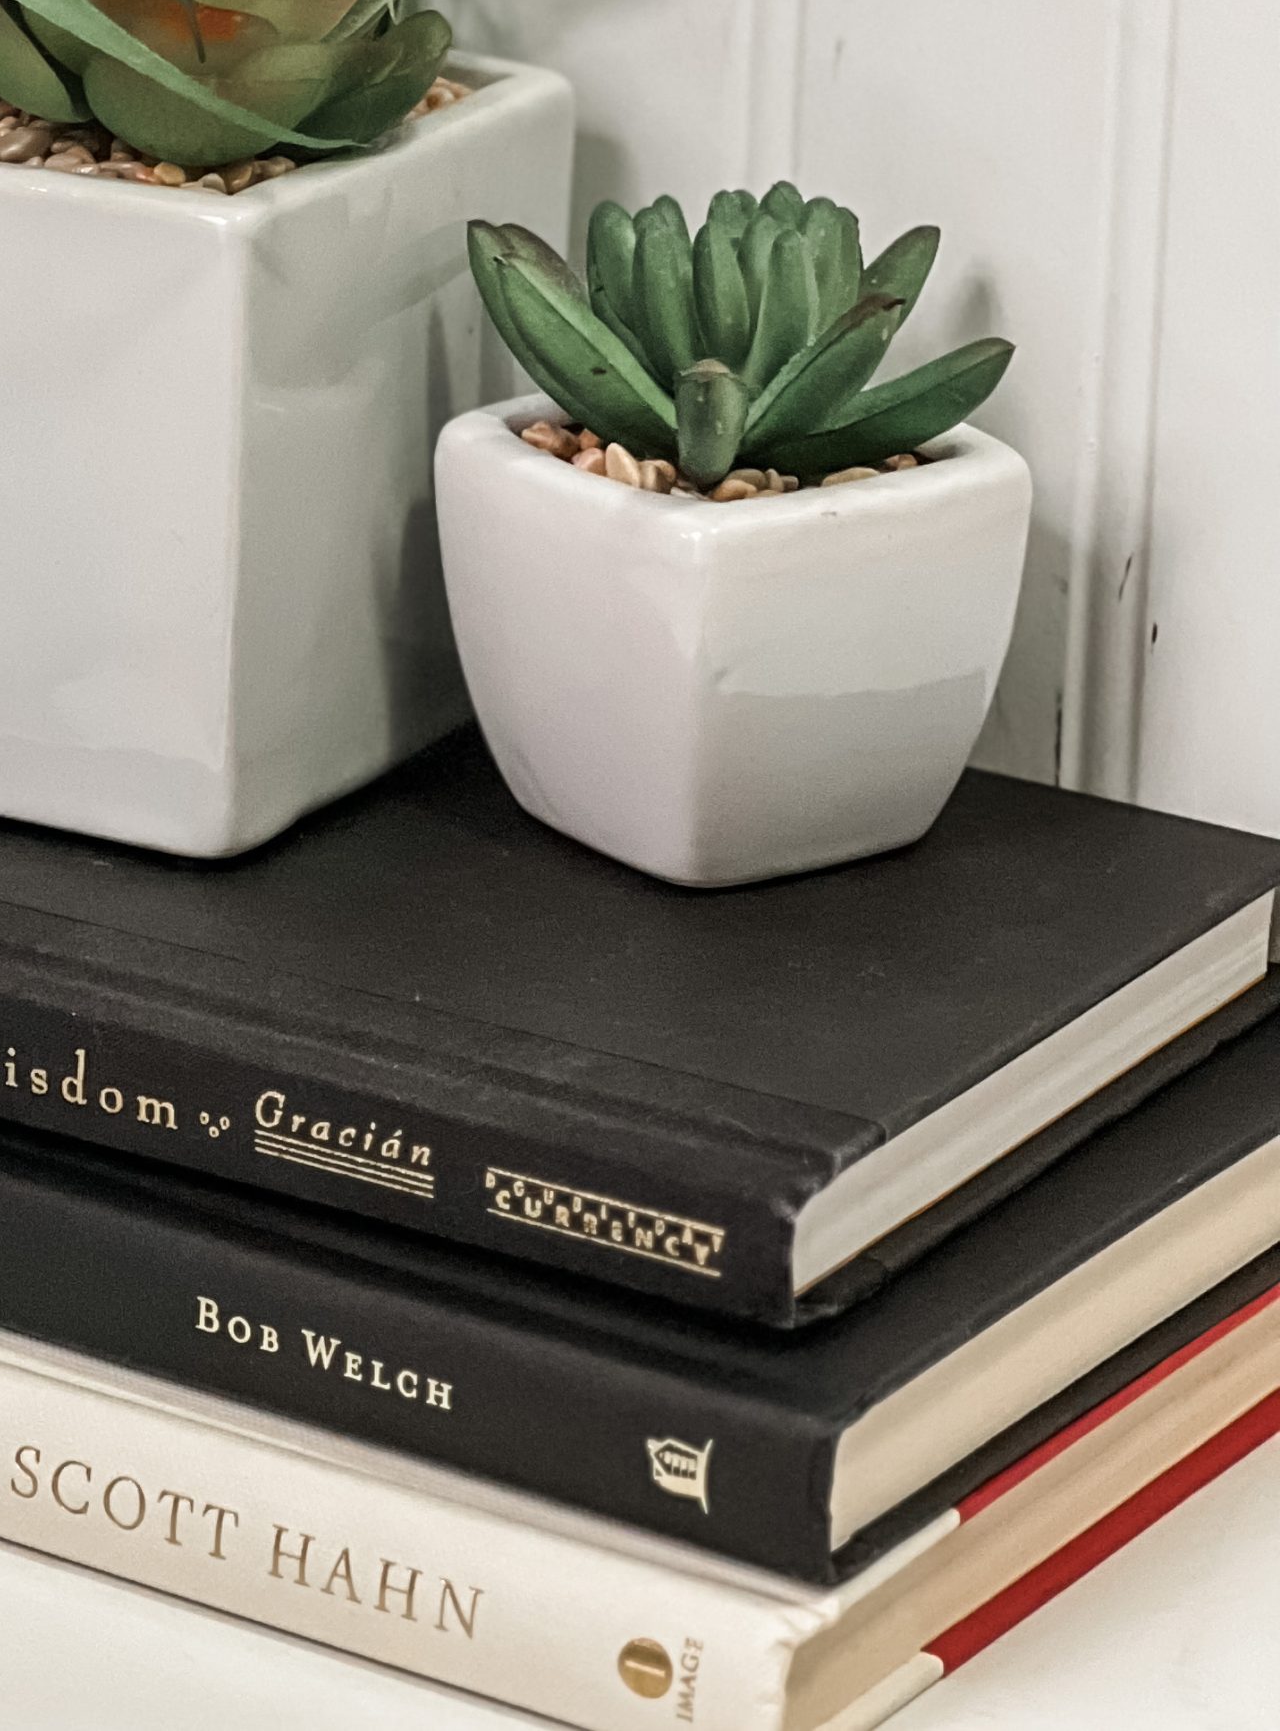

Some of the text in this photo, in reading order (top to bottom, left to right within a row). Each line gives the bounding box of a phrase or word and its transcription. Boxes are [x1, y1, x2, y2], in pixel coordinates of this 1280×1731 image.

[254, 1091, 433, 1166] Gracián
[495, 1190, 710, 1266] CURRENCY
[195, 1296, 454, 1410] BOB WELCH
[9, 1445, 485, 1641] SCOTT HAHN
[676, 1636, 704, 1723] IMAGE
